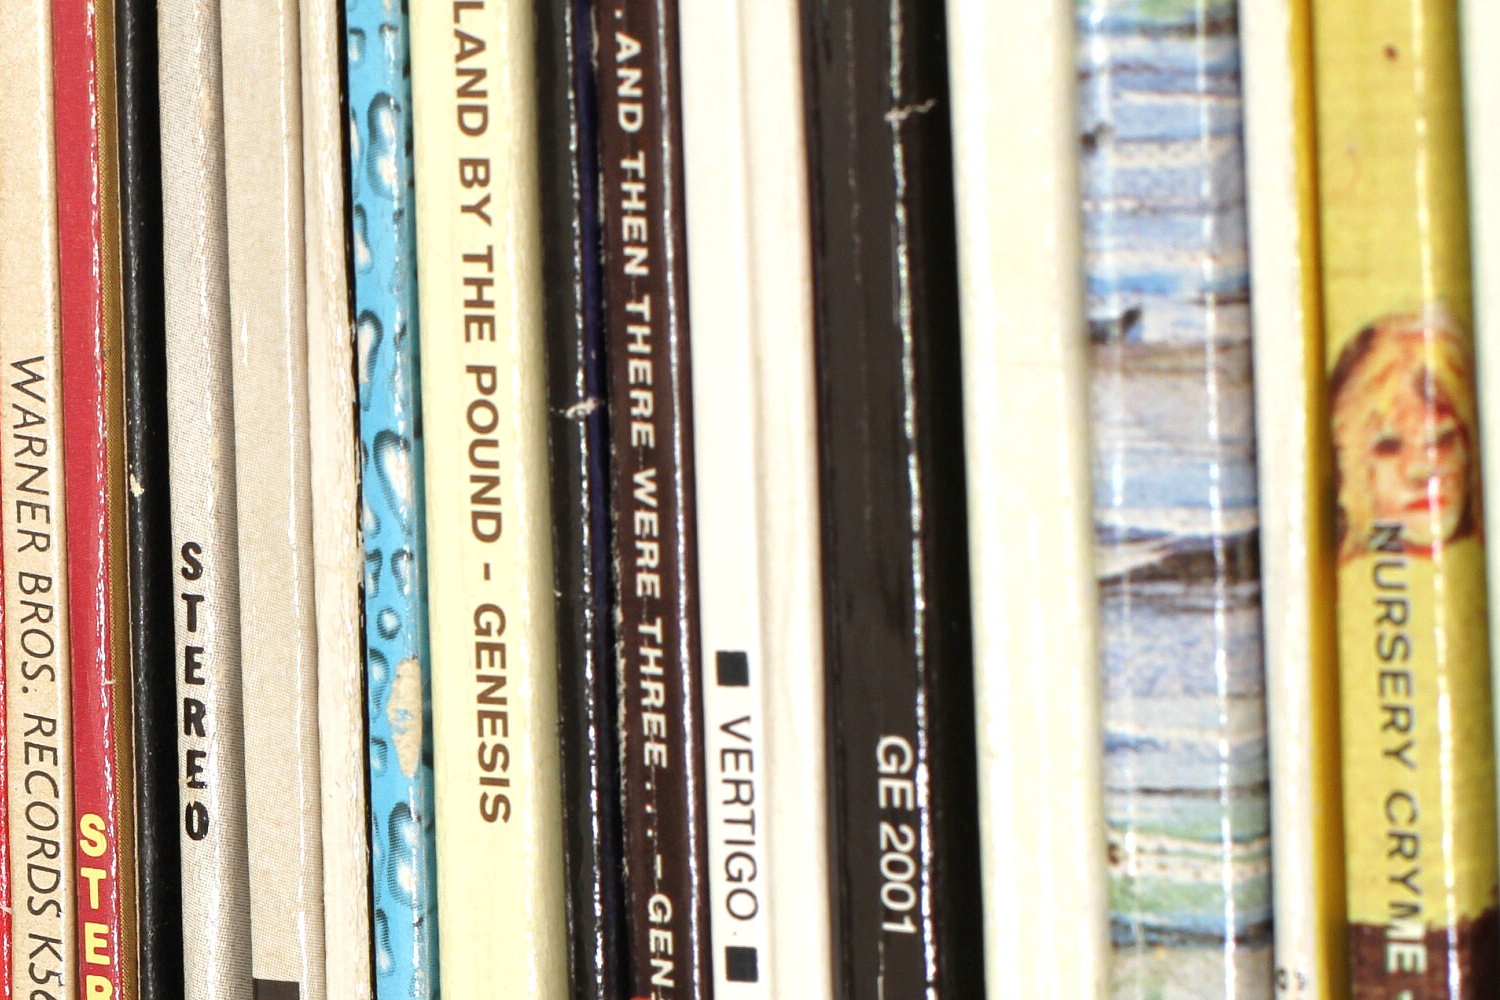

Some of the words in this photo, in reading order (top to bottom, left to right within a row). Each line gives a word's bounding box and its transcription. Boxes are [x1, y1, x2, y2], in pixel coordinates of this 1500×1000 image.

[453, 0, 489, 138] LAND
[614, 32, 644, 134] AND
[458, 157, 493, 227] BY
[620, 151, 649, 277] THEN
[461, 245, 496, 343] THE
[625, 294, 655, 448] THERE
[10, 355, 51, 553] WARNER
[465, 364, 503, 543] POUND
[632, 468, 661, 600] WERE
[17, 571, 55, 694] BROS.
[181, 541, 210, 841] STEREO
[1368, 521, 1416, 770] NURSERY
[473, 603, 512, 824] GENESIS
[875, 735, 914, 811] GE
[22, 712, 62, 919] RECORDS
[720, 715, 759, 921] VERTIGO
[878, 821, 917, 935] 2001
[1383, 789, 1428, 975] CRYME
